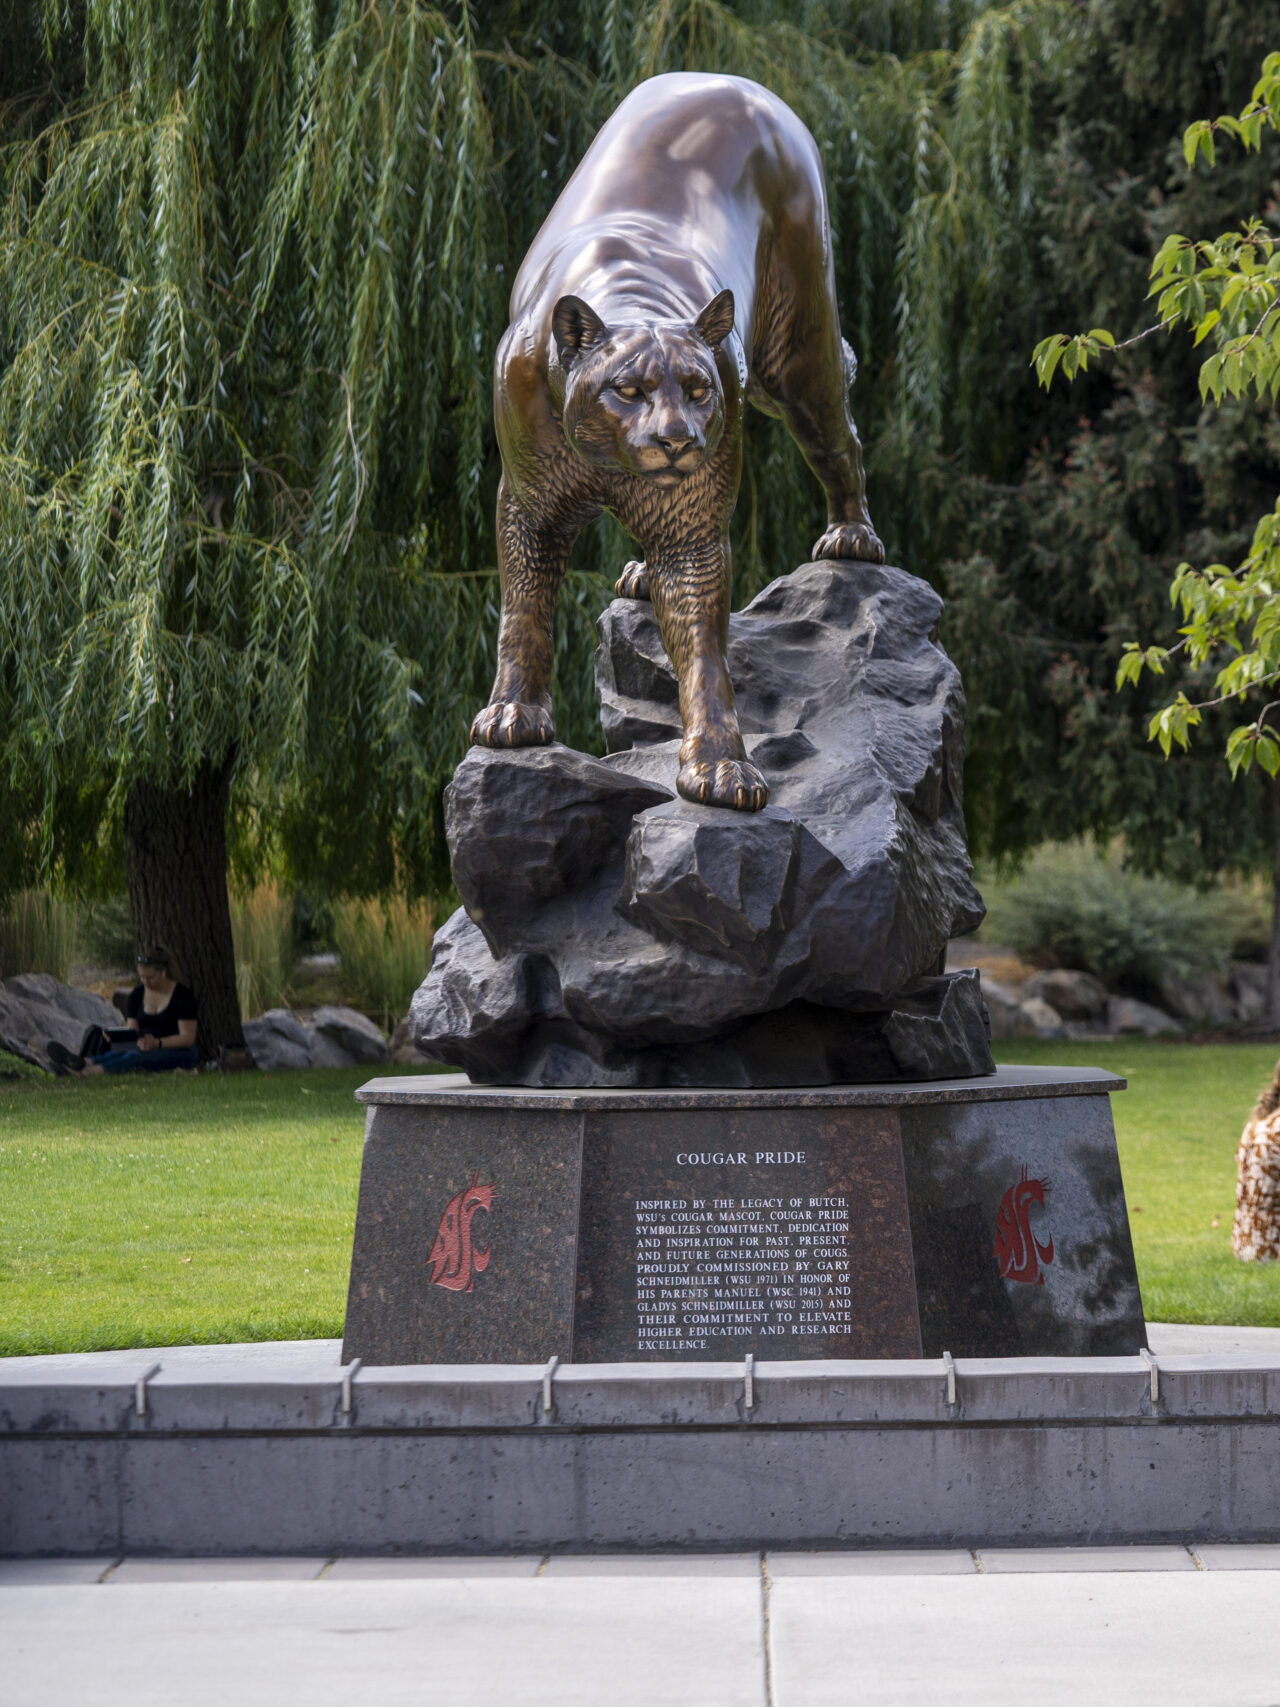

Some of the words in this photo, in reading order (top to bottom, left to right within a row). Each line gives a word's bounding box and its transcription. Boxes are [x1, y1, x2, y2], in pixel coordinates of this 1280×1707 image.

[677, 1153, 747, 1165] COUGAR
[756, 1152, 805, 1164] PRIDE
[636, 1200, 687, 1210] INSPIRED
[693, 1200, 705, 1209] BY
[713, 1199, 734, 1209] THE
[741, 1199, 783, 1208] LEGACY
[790, 1198, 802, 1207] OF
[671, 1213, 713, 1222] COUGAR
[770, 1211, 812, 1220] COUGAR
[819, 1211, 848, 1220] PRIDE
[636, 1226, 701, 1235] SYMBOLIZES
[789, 1223, 848, 1233] DEDICATION
[637, 1239, 660, 1248] AND
[667, 1238, 733, 1247] INSPIRATION
[740, 1237, 759, 1246] FOR
[637, 1252, 660, 1261] AND
[667, 1251, 710, 1260] FUTURE
[716, 1250, 789, 1259] GENERATIONS
[795, 1249, 807, 1258] OF
[637, 1264, 689, 1273] PROUDLY
[697, 1262, 788, 1272] COMMISSIONED
[796, 1262, 809, 1271] BY
[818, 1261, 849, 1271] GARY
[637, 1276, 719, 1286] SCHNEIDMILLER
[726, 1276, 751, 1285] (WSU
[757, 1275, 777, 1284] 1971)
[782, 1273, 794, 1284] IN
[801, 1274, 832, 1284] HONOR
[839, 1274, 850, 1283] OF
[638, 1290, 655, 1298] HIS
[661, 1289, 708, 1298] PARENTS
[715, 1288, 761, 1298] MANUEL
[767, 1288, 793, 1298] (WSC
[800, 1287, 821, 1297] 1941)
[827, 1287, 850, 1296] AND
[638, 1302, 676, 1312] GLADYS
[682, 1301, 764, 1311] SCHNEIDMILLER
[770, 1300, 795, 1310] (WSU
[802, 1300, 823, 1309] 2015)
[829, 1299, 851, 1309] AND
[638, 1315, 675, 1324] THEIR
[683, 1314, 769, 1323] COMMITMENT
[777, 1313, 792, 1322] TO
[800, 1312, 851, 1322] ELEVATE
[639, 1328, 682, 1337] HIGHER
[689, 1327, 752, 1336] EDUCATION
[760, 1326, 784, 1335] AND
[792, 1325, 851, 1335] RESEARCH
